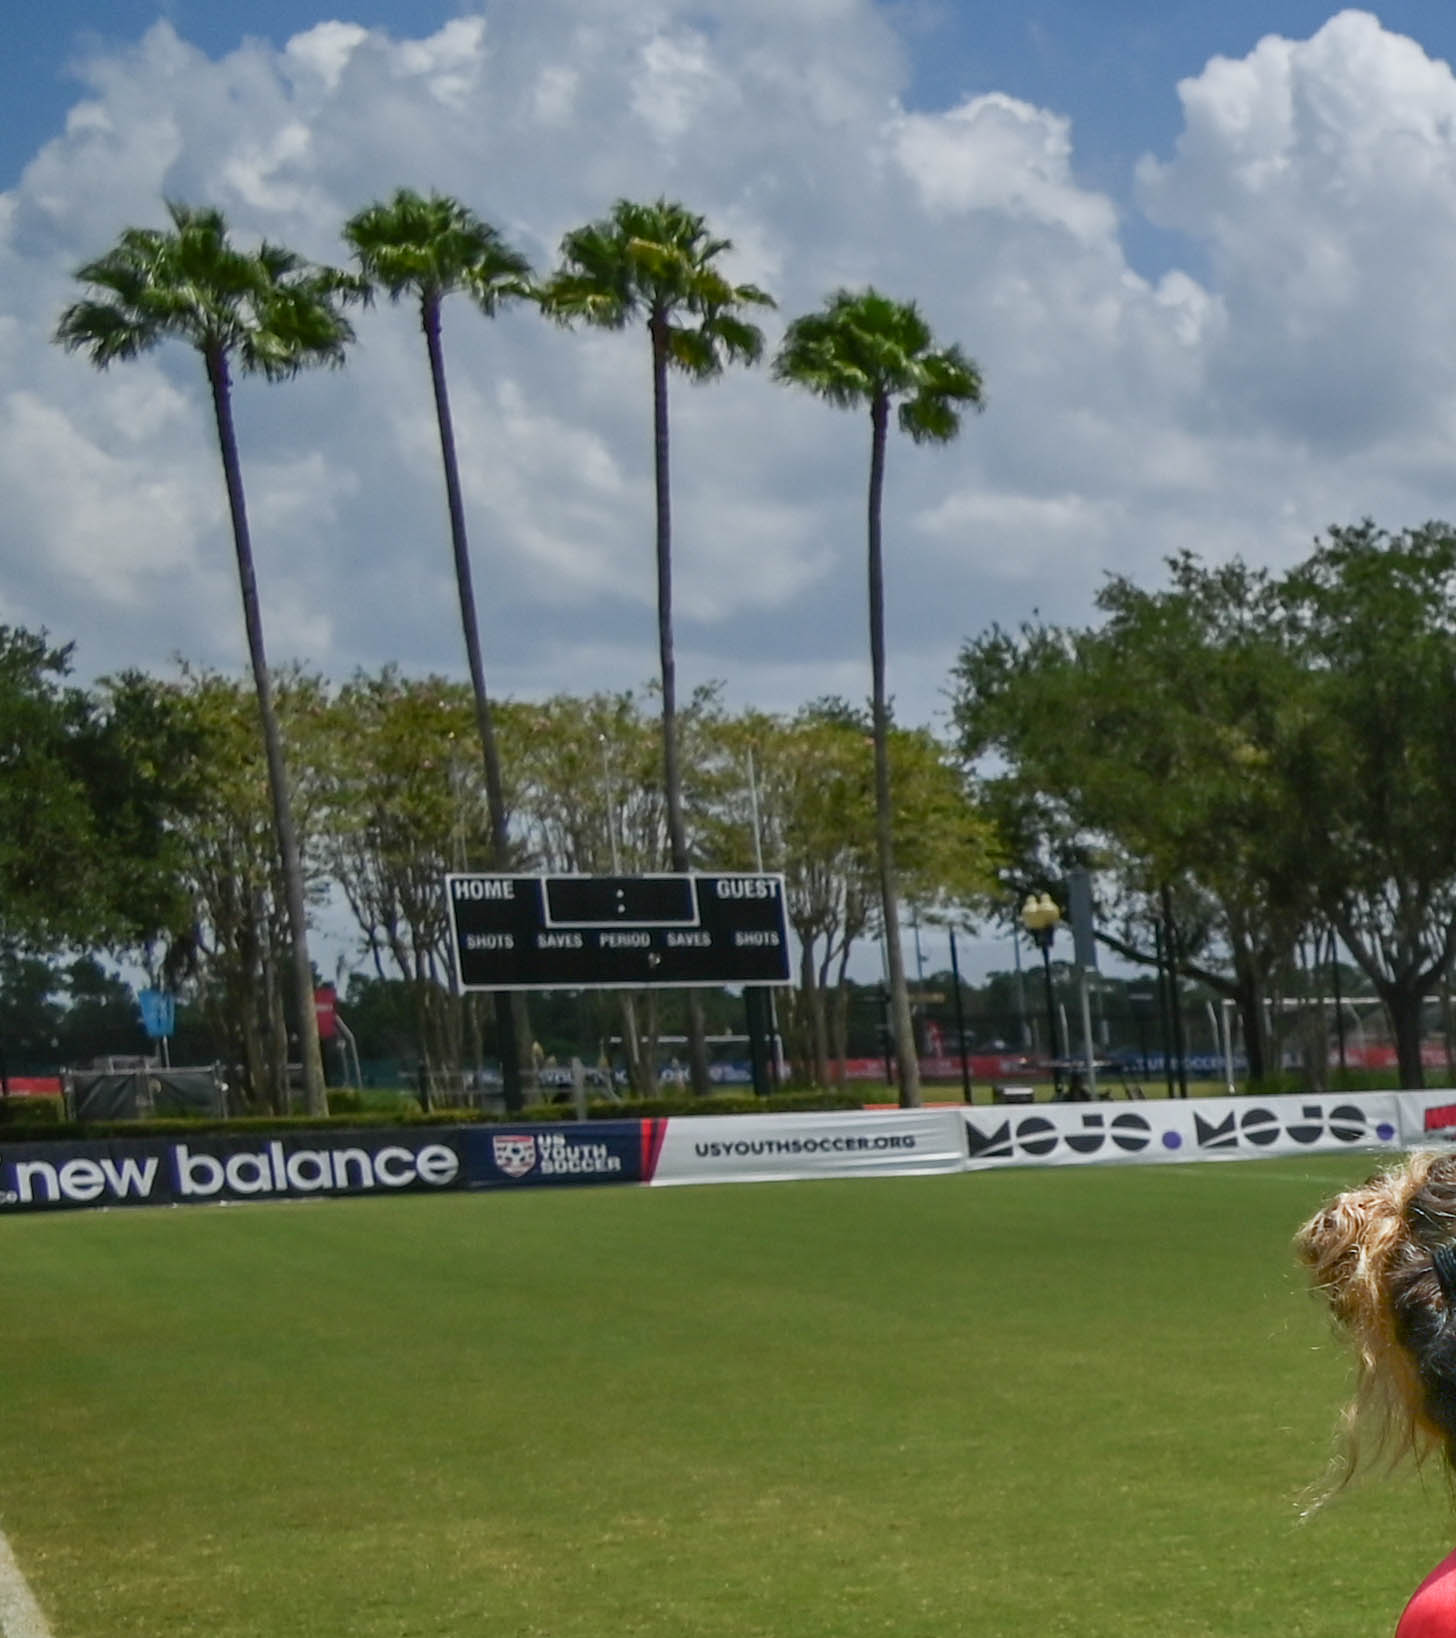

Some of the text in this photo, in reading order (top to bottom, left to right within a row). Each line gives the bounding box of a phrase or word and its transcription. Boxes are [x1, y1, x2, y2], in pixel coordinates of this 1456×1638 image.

[454, 880, 515, 900] HOME
[716, 879, 779, 898] GUEST
[466, 930, 779, 949] SHOTS SAVES PERIOD SAVES SHOTS
[537, 1133, 566, 1147] US
[694, 1134, 916, 1158] USYOUTHSOCCER.ORG
[539, 1143, 608, 1161] YOUTH
[16, 1139, 460, 1202] new balance
[540, 1155, 621, 1175] SOCCER
